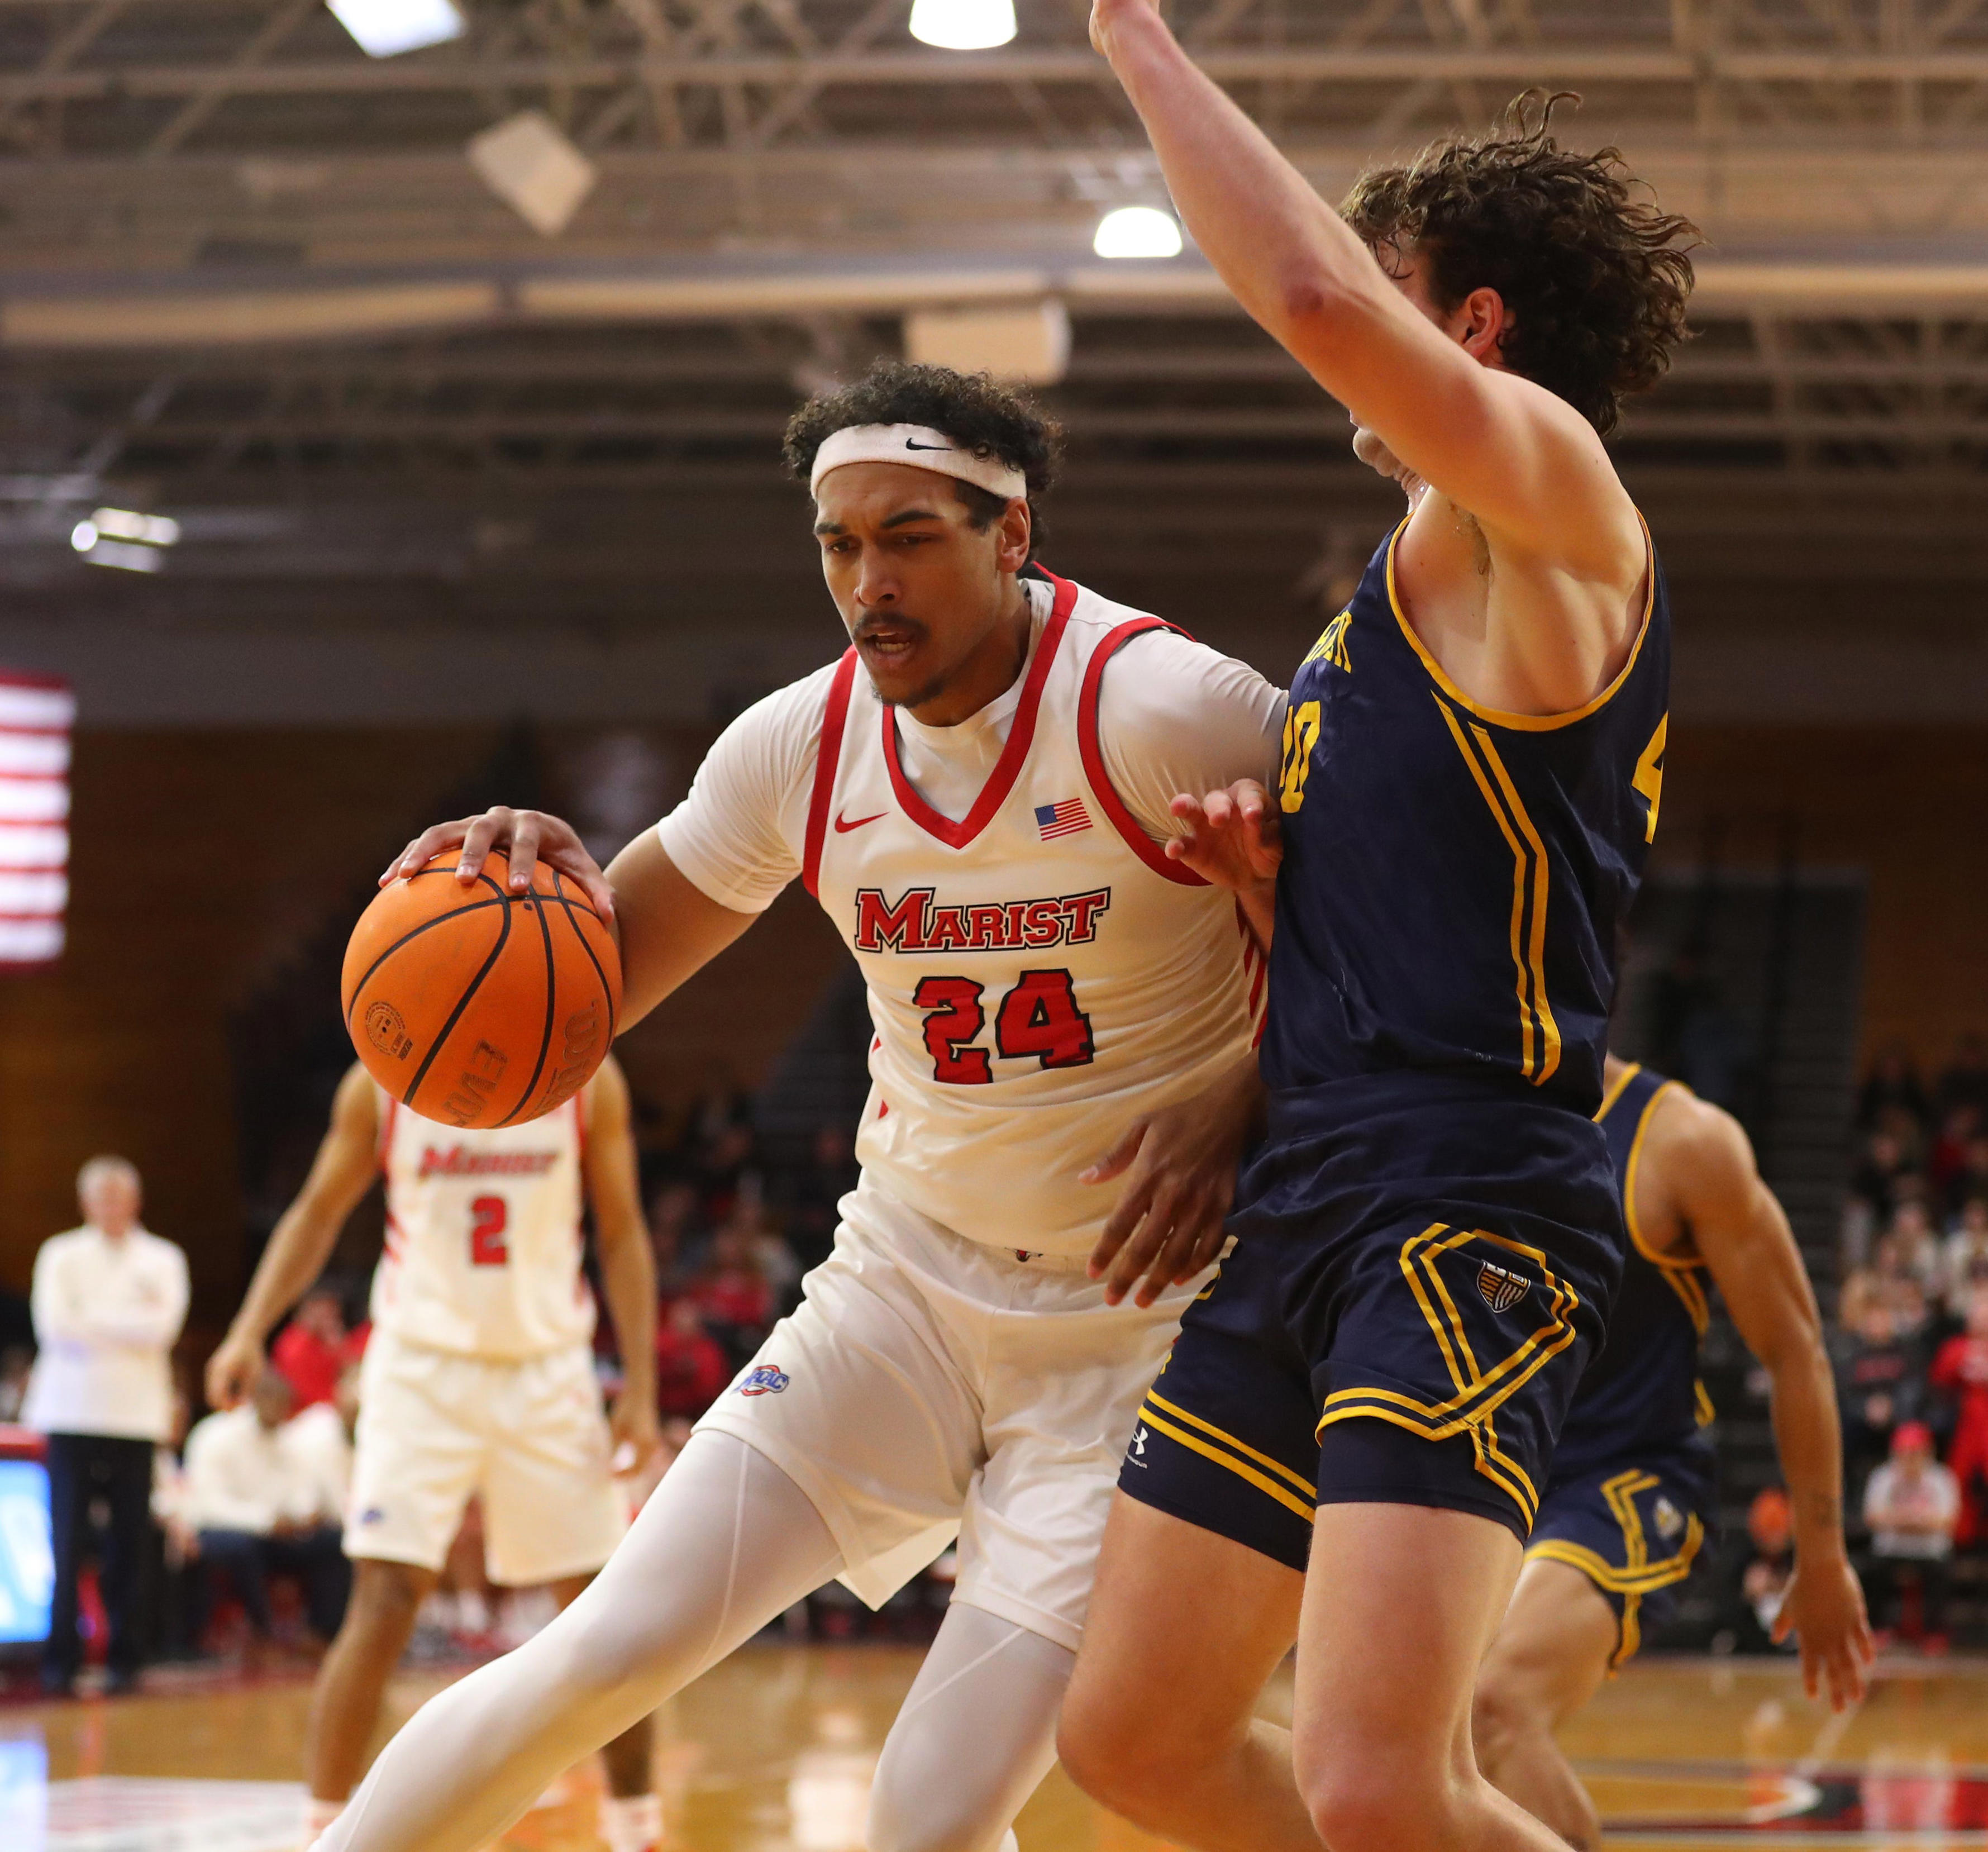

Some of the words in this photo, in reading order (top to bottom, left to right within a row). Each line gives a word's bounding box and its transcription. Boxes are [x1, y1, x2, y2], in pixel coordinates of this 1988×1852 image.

[855, 887, 1111, 953] MARIST
[912, 968, 1095, 1084] 24
[470, 1194, 509, 1265] 2
